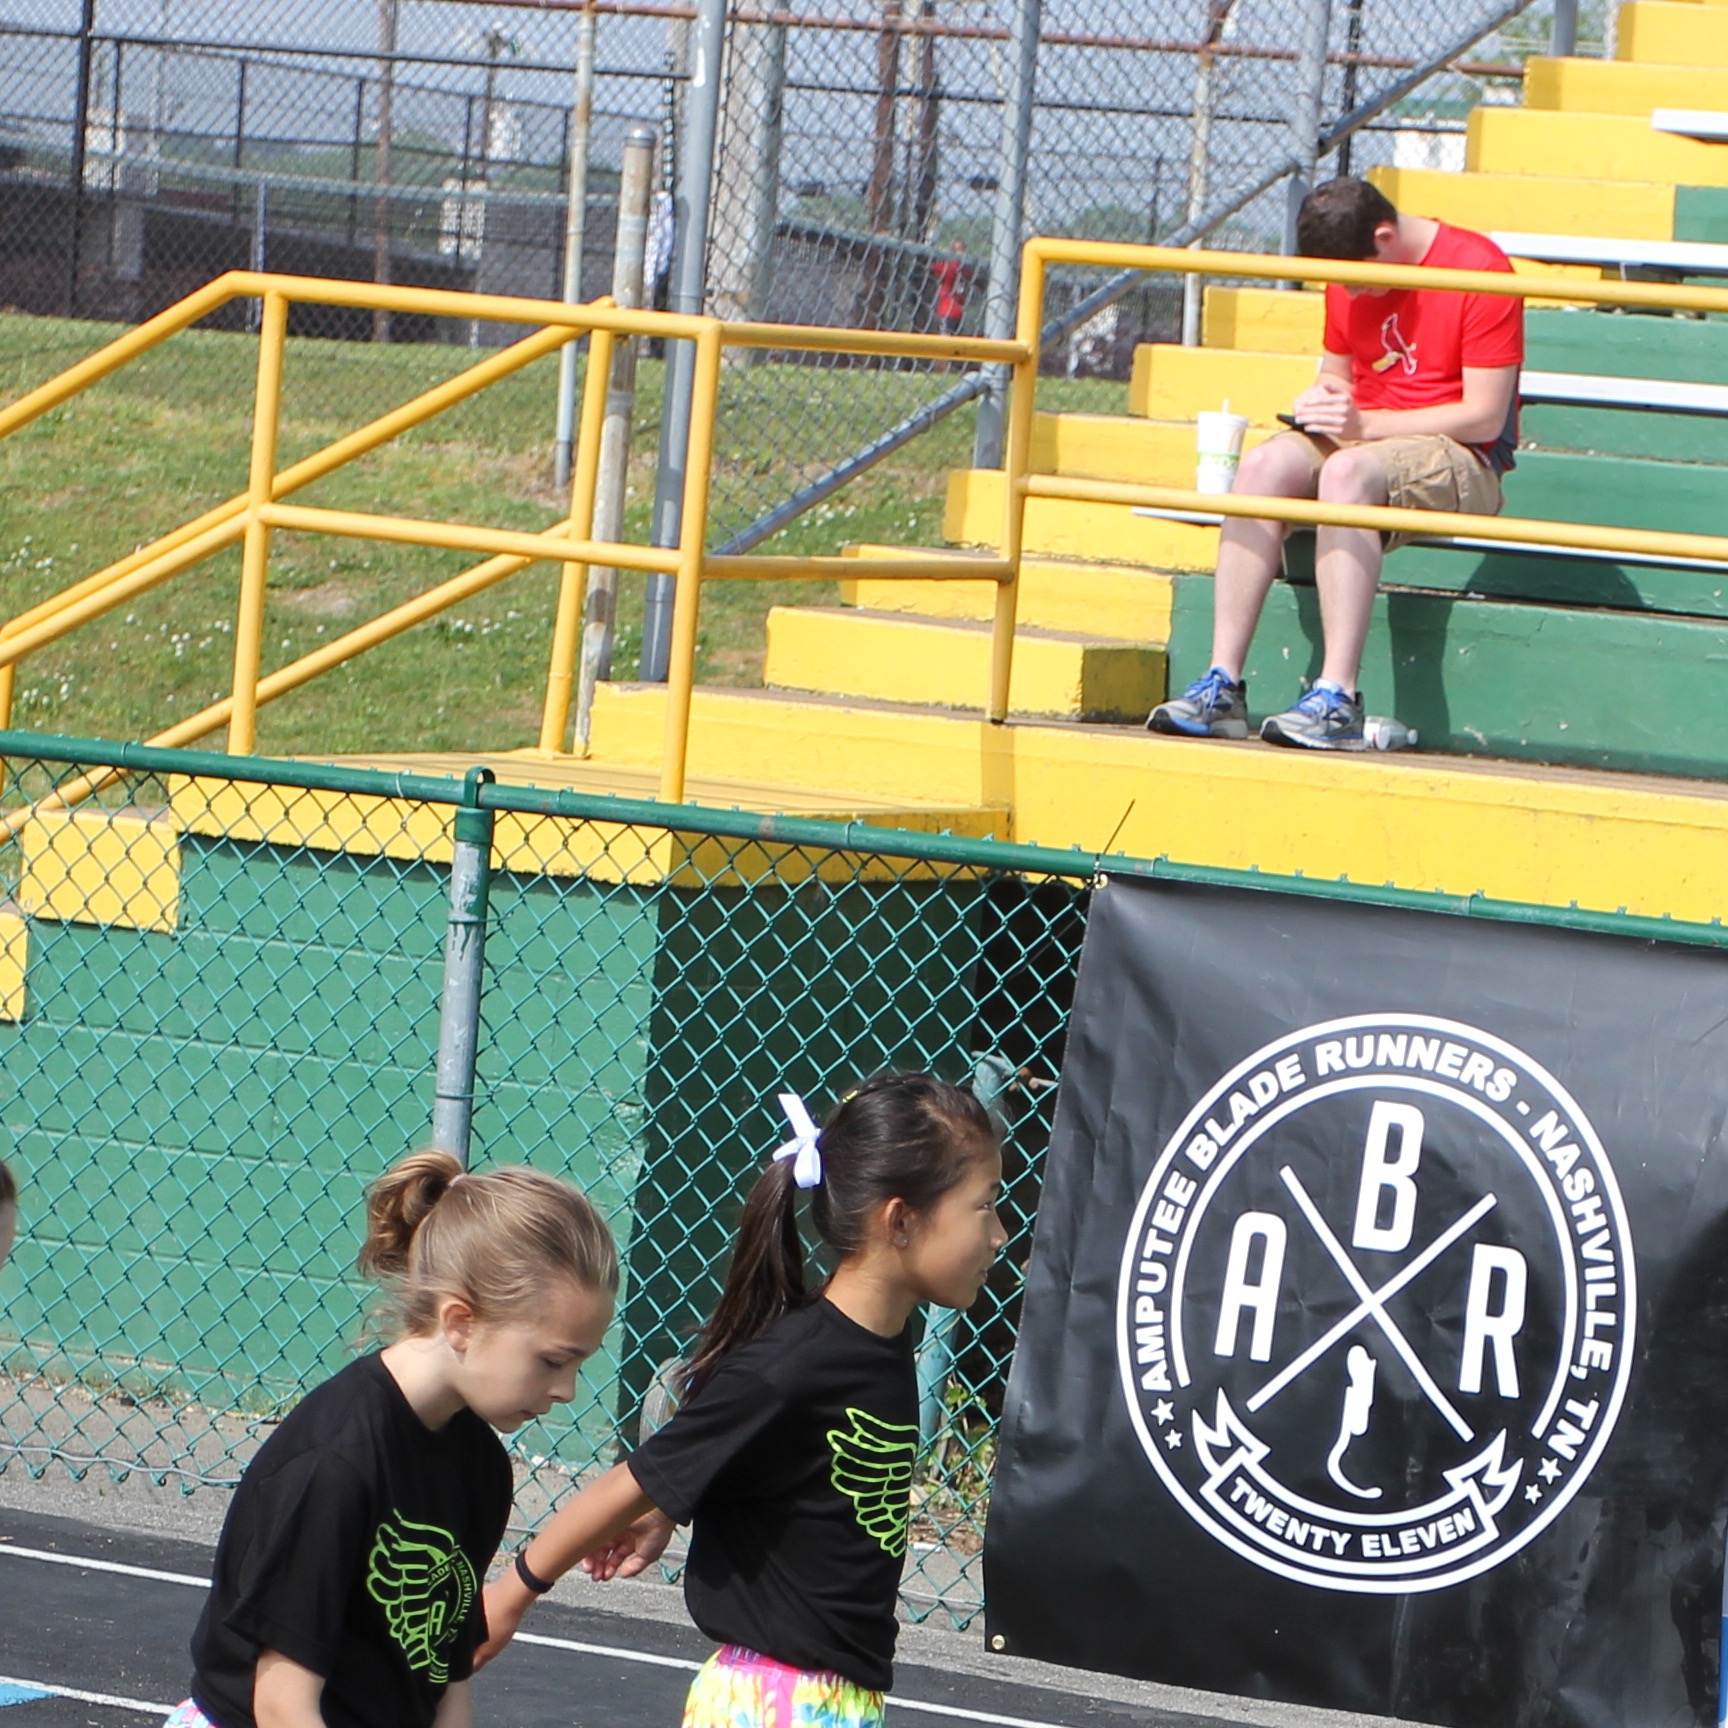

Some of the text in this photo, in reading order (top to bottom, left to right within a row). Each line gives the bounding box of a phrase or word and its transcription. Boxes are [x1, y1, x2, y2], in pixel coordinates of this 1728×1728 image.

[1137, 1034, 1619, 1463] AMPUTEE BLADE RUNNERS NASHVILLE, TN
[1353, 1100, 1426, 1253] B
[1214, 1210, 1288, 1362] A
[1459, 1243, 1528, 1399] R
[1229, 1477, 1476, 1559] TWENTY ELEVEN
